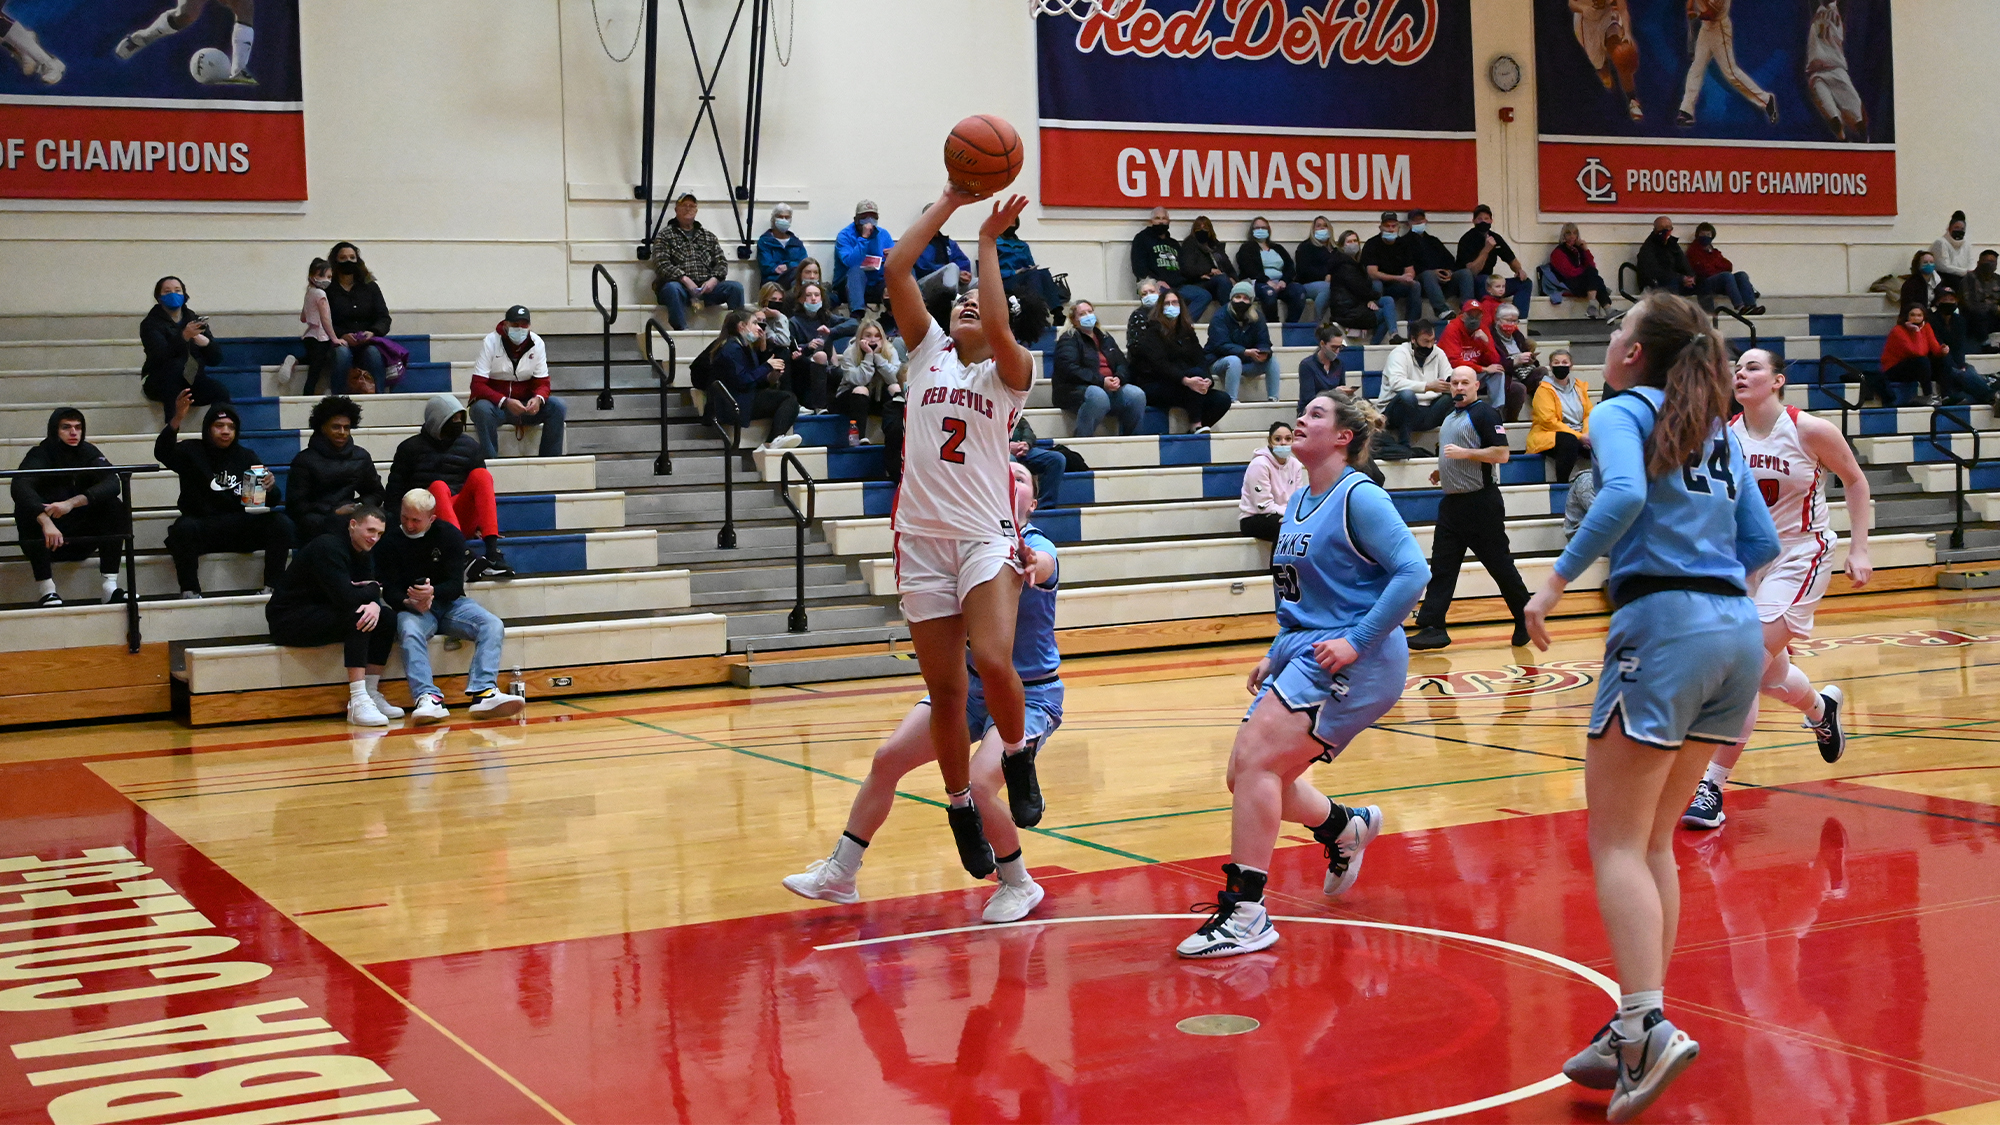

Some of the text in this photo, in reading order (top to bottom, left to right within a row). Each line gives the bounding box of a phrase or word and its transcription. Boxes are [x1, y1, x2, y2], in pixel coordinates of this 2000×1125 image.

[1211, 0, 1439, 68] Devils
[0, 138, 250, 174] F CHAMPIONS
[1116, 146, 1413, 201] GYMNASIUM
[1626, 168, 1868, 196] PROGRAM OF CHAMPIONS
[921, 386, 994, 420] RED DEVILS
[939, 416, 967, 465] 2
[1682, 437, 1737, 502] 24
[1749, 453, 1790, 476] DEVILS
[1272, 563, 1302, 605] 50
